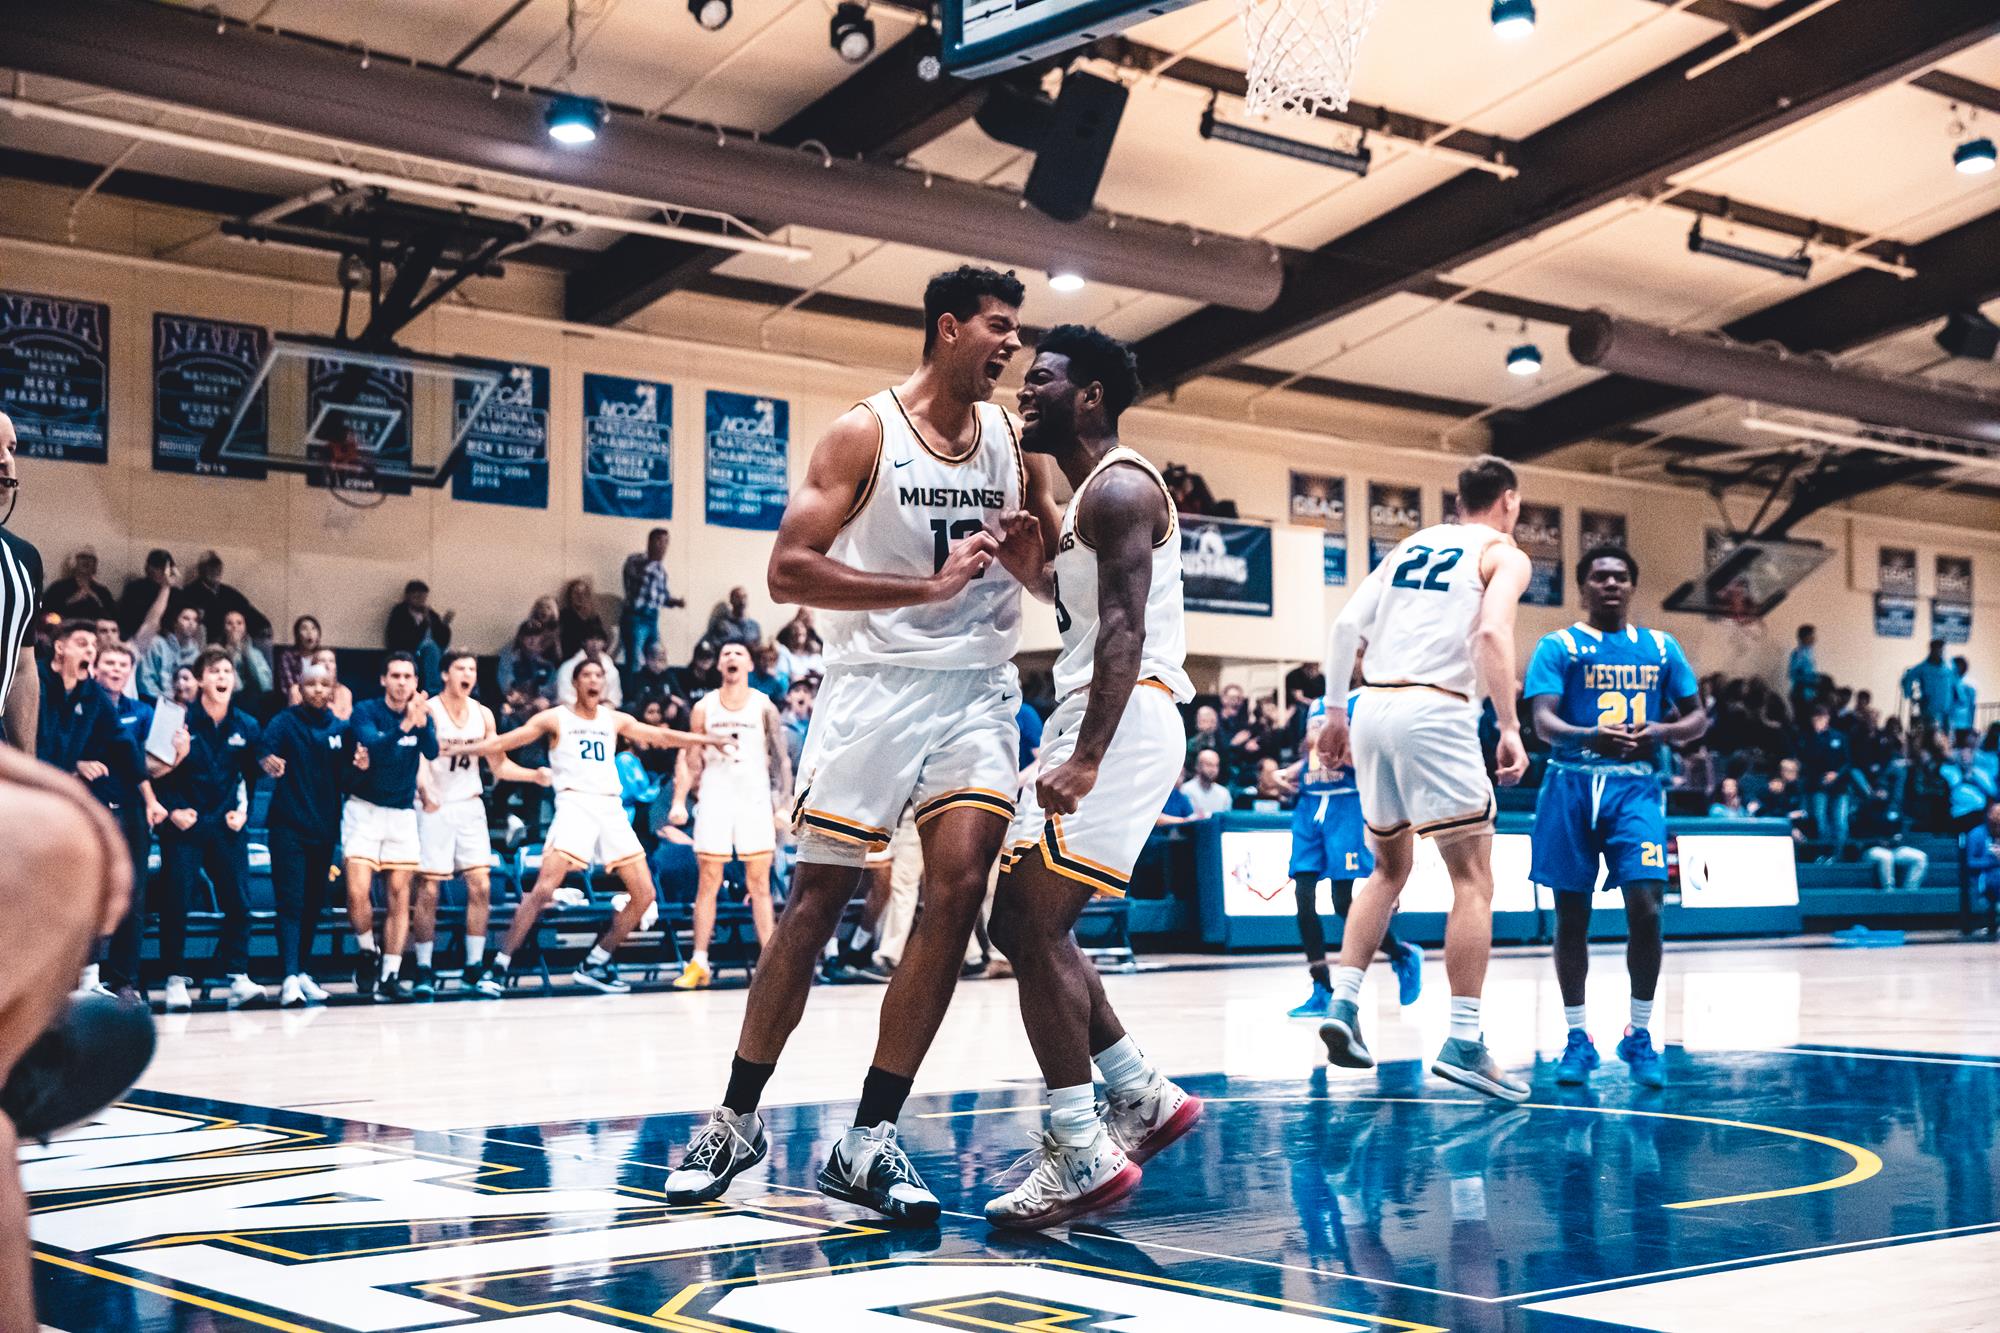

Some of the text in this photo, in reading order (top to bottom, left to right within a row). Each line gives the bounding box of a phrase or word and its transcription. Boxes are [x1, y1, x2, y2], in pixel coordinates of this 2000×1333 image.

[159, 316, 261, 369] NAIA
[14, 348, 80, 366] NATIONAL
[29, 361, 67, 374] MEET
[181, 370, 242, 388] NATIONAL
[4, 388, 89, 409] MARATHON
[594, 421, 660, 442] NATIONAL
[587, 433, 670, 460] CHAMPIONS
[716, 435, 777, 454] NATIONAL
[709, 447, 787, 468] CHAMPIONS
[900, 486, 1005, 509] MUSTANGS
[1391, 545, 1464, 592] 22
[1584, 664, 1660, 690] WESTCLIFF
[1597, 691, 1647, 728] 21
[578, 739, 605, 762] 20
[1640, 841, 1665, 868] 21
